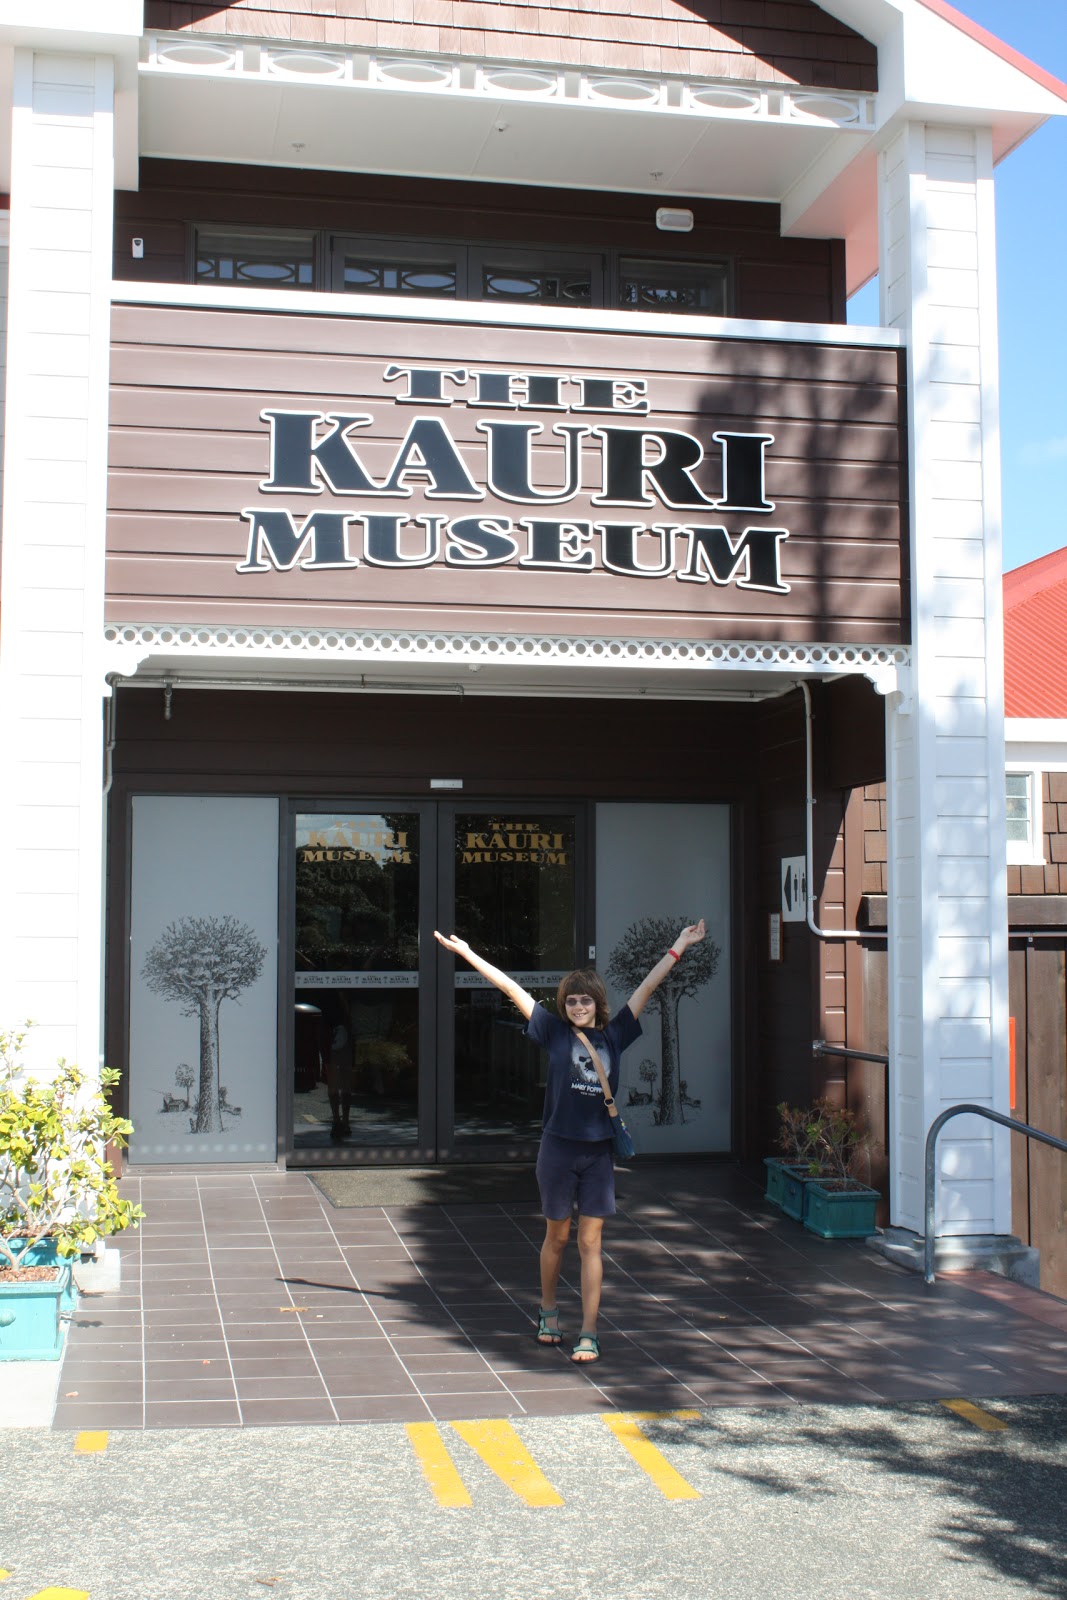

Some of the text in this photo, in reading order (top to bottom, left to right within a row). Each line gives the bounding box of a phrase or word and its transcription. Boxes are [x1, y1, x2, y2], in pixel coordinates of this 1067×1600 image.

[384, 363, 650, 415] THE
[259, 408, 775, 511] KAURI
[237, 508, 791, 594] MUSEUM
[489, 822, 540, 831] THE
[308, 831, 409, 848] KAURI
[466, 832, 564, 849] KAURI
[303, 850, 412, 865] MUSEUM
[461, 851, 567, 866] MUSEUM
[571, 1082, 586, 1090] MARY
